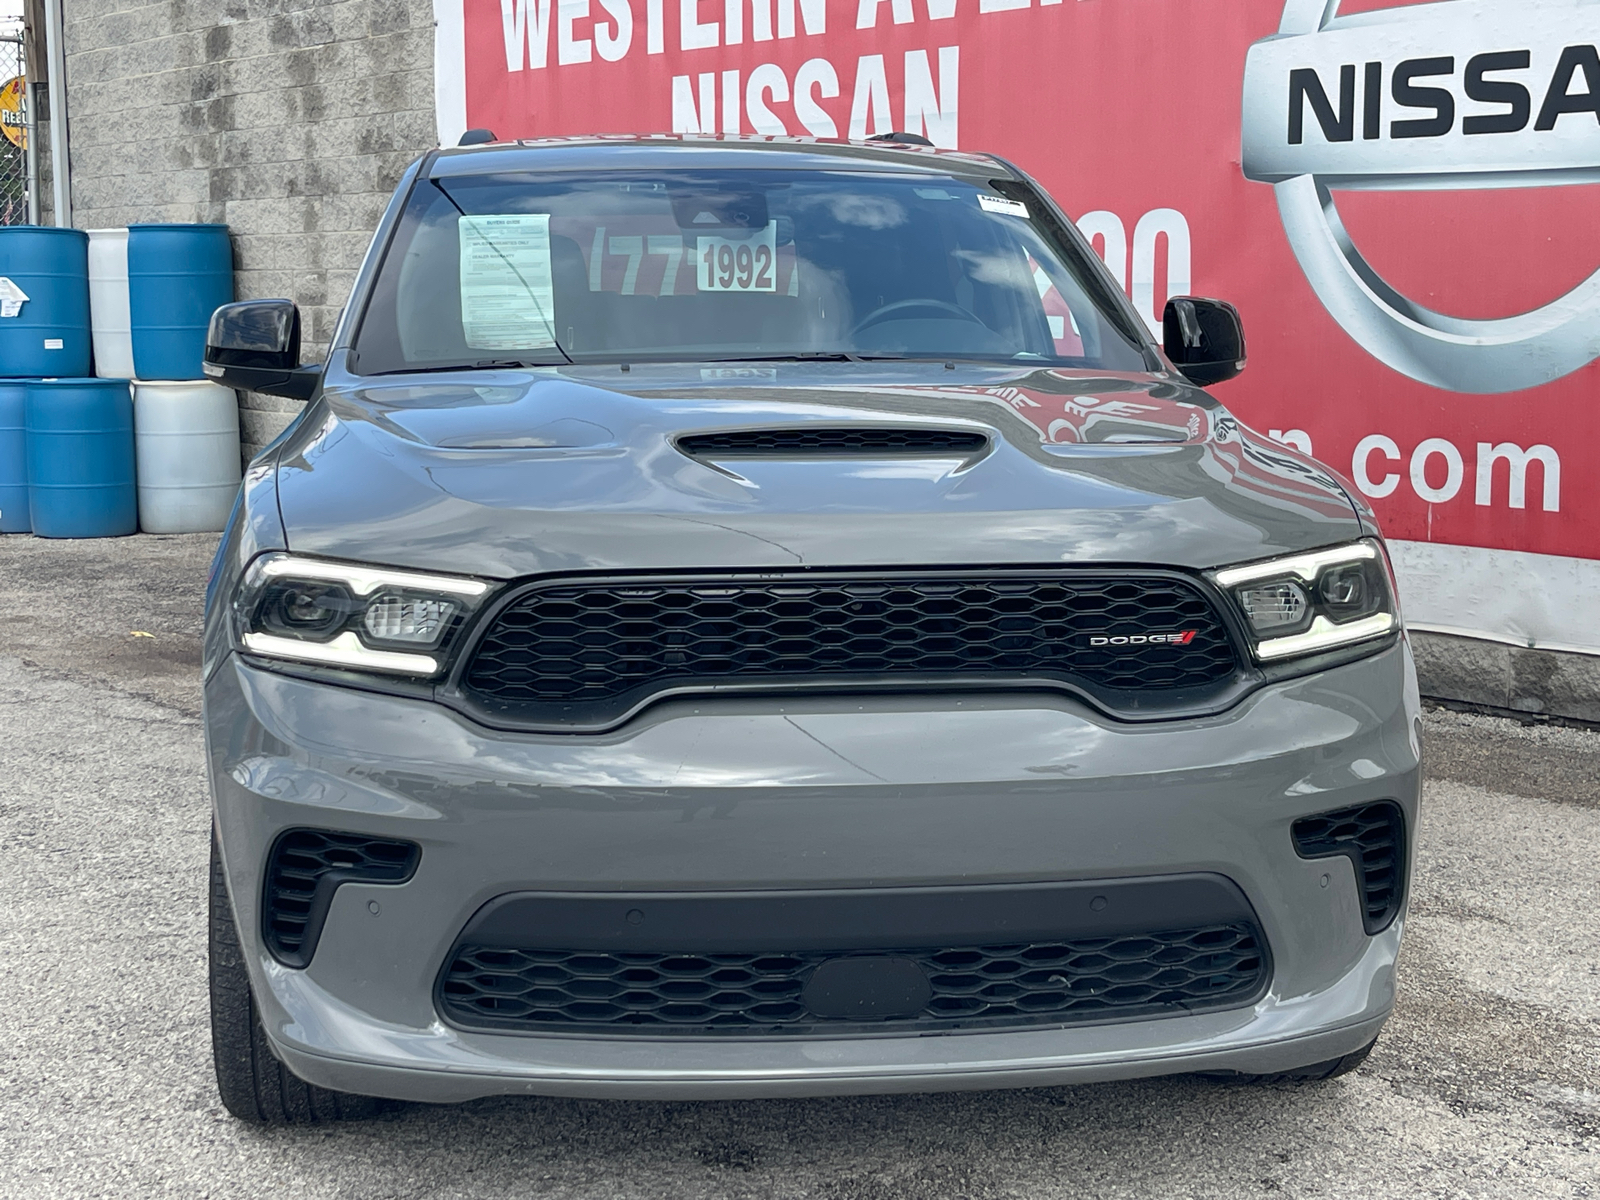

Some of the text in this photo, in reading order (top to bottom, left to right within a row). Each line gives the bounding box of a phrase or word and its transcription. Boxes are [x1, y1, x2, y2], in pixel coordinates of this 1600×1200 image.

[672, 46, 959, 151] NISSAN
[703, 244, 772, 289] 1992
[1090, 633, 1183, 646] DODGE
